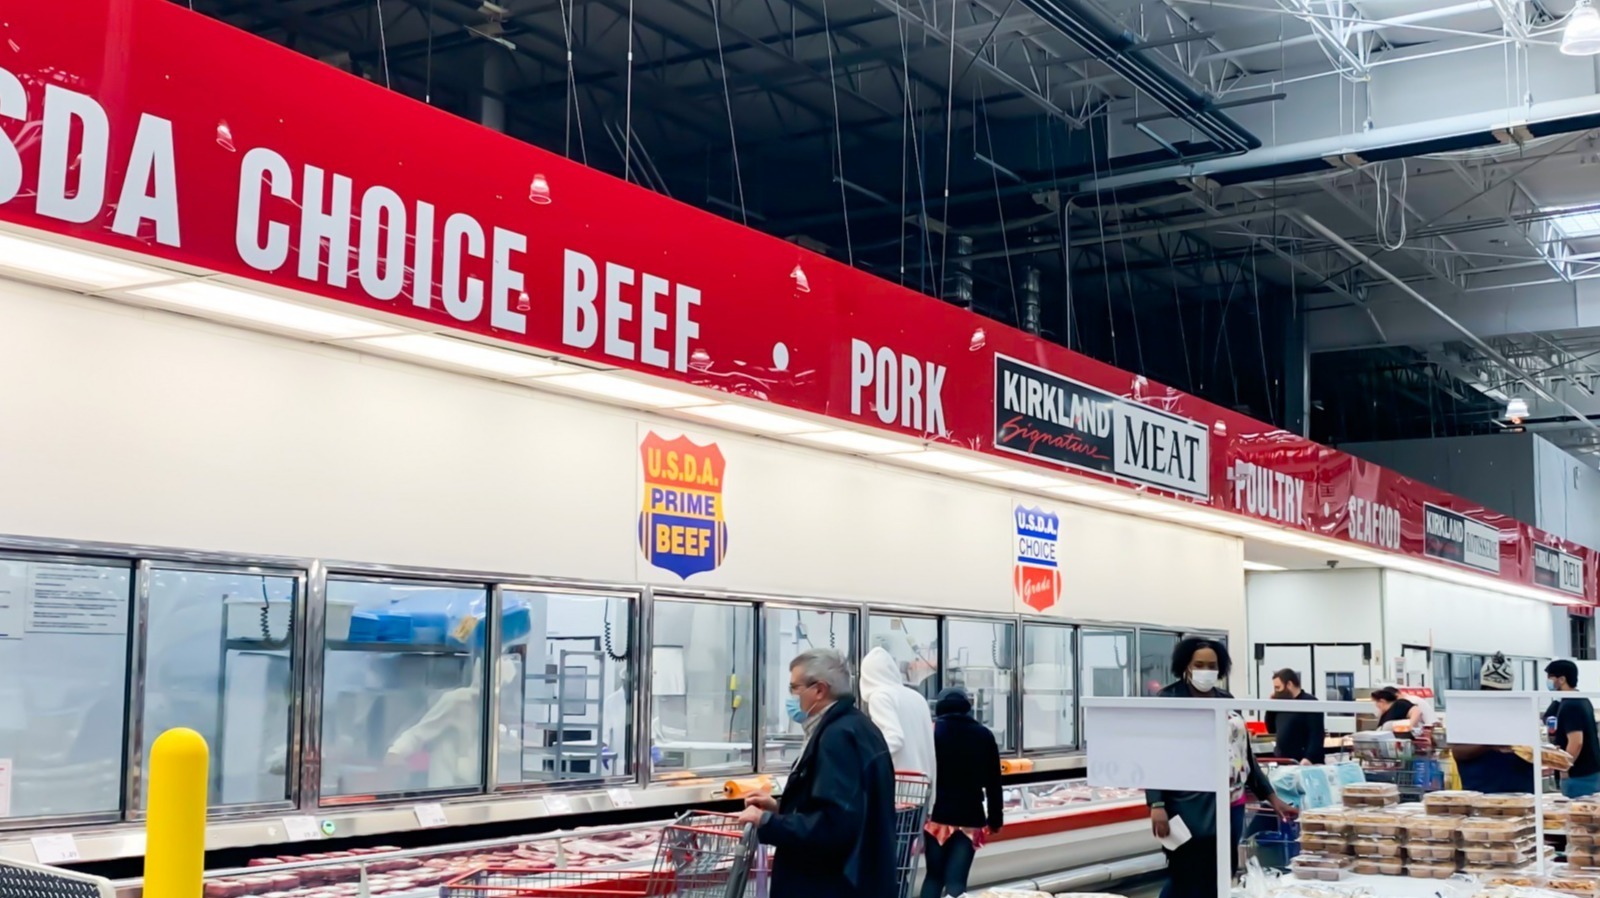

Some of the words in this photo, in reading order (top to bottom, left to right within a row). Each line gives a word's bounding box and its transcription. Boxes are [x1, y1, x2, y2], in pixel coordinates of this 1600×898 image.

[235, 147, 527, 334] CHOICE
[562, 249, 701, 373] BEEF
[851, 338, 946, 437] PORK
[1004, 370, 1110, 438] KIRKLAND
[1002, 415, 1110, 460] Signature
[1123, 415, 1200, 482] MEAT
[648, 447, 719, 486] U.S.D.A.
[652, 488, 715, 517] PRIME
[1234, 459, 1304, 525] POULTRY
[656, 523, 711, 557] BEEF
[1018, 512, 1057, 535] U.S.D.A.
[1348, 495, 1400, 549] SEAFOOD
[1426, 510, 1464, 543] KIRKLAND
[1019, 538, 1056, 560] CHOICE
[1024, 575, 1051, 603] Grade
[1563, 560, 1580, 588] DELI
